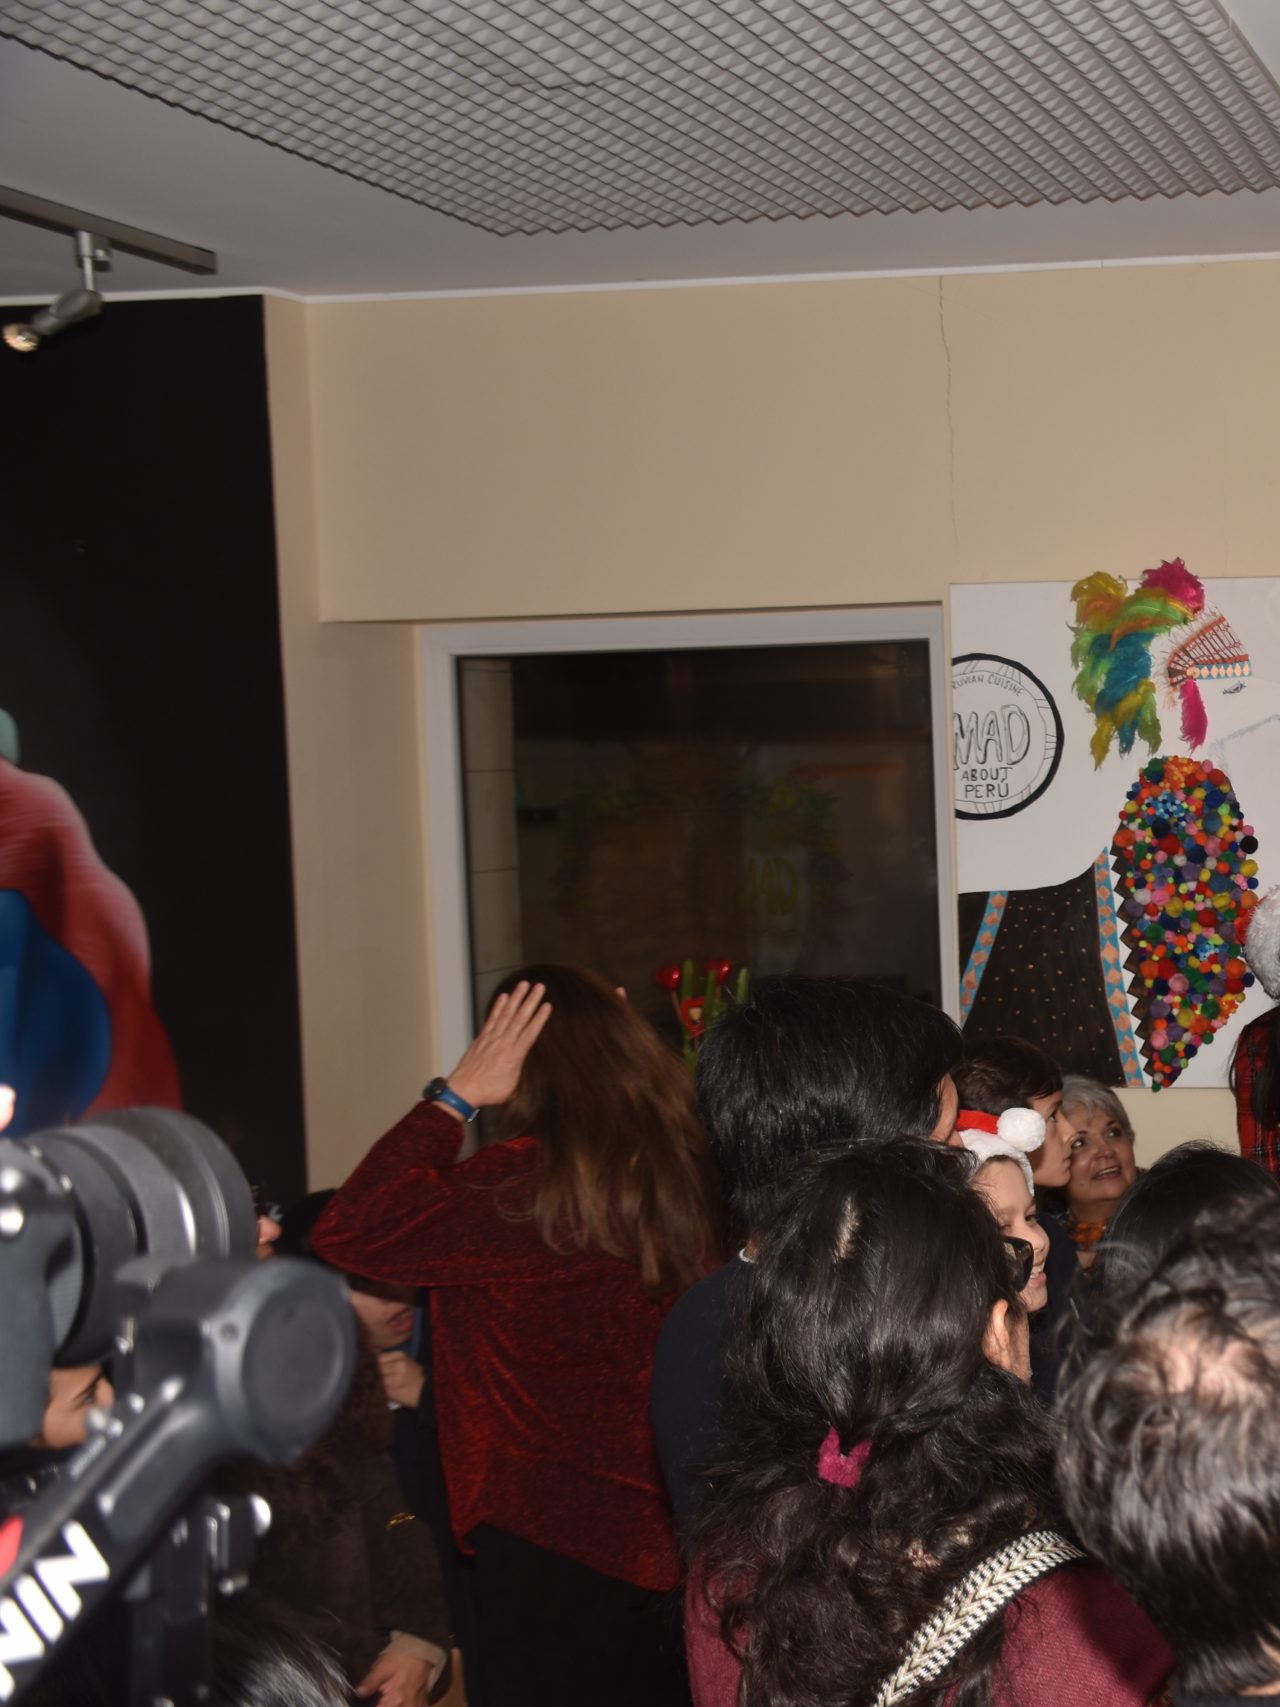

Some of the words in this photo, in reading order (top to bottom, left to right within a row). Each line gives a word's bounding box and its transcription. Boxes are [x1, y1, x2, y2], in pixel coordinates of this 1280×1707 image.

[988, 674, 1024, 697] CUISINE
[953, 703, 1031, 770] MAD
[960, 766, 1014, 783] ABOUT
